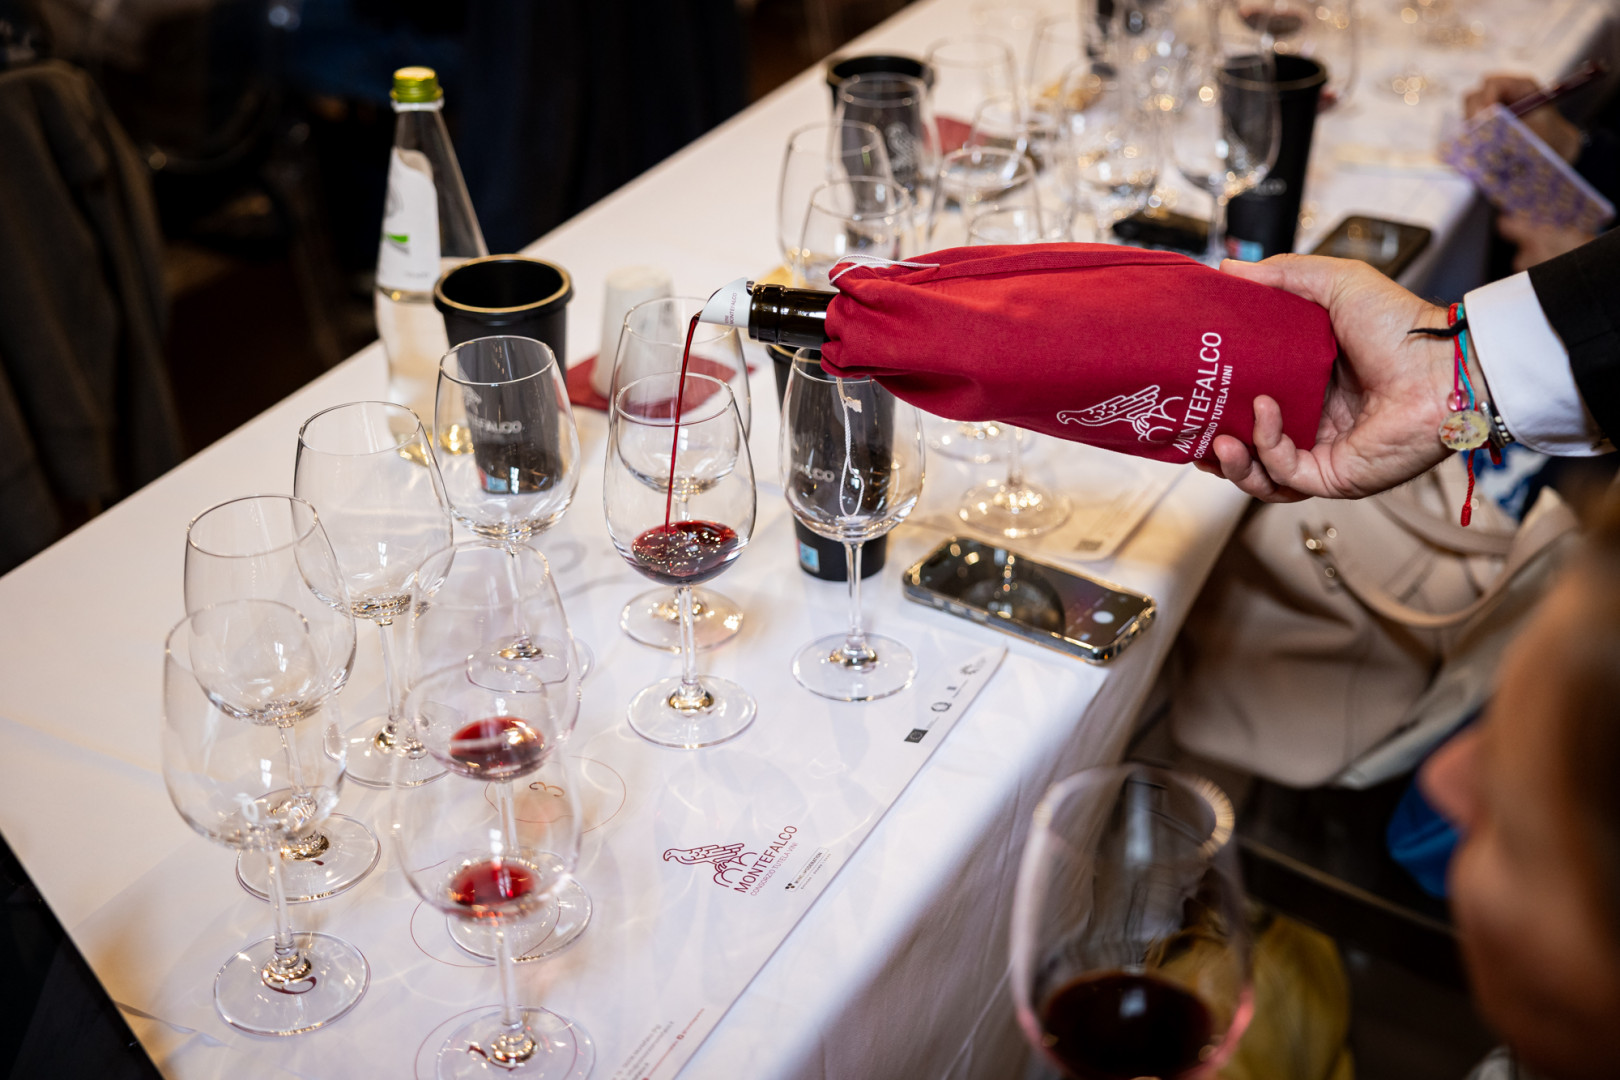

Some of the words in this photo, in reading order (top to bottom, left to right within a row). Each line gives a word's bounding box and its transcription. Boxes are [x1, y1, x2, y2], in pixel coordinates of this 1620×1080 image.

[1172, 332, 1222, 454] MONTEFALCO
[1193, 422, 1218, 459] CONSORZIO
[1211, 387, 1230, 420] TUTELA
[1221, 365, 1233, 385] VINI
[733, 825, 798, 893] MONTEFALCO
